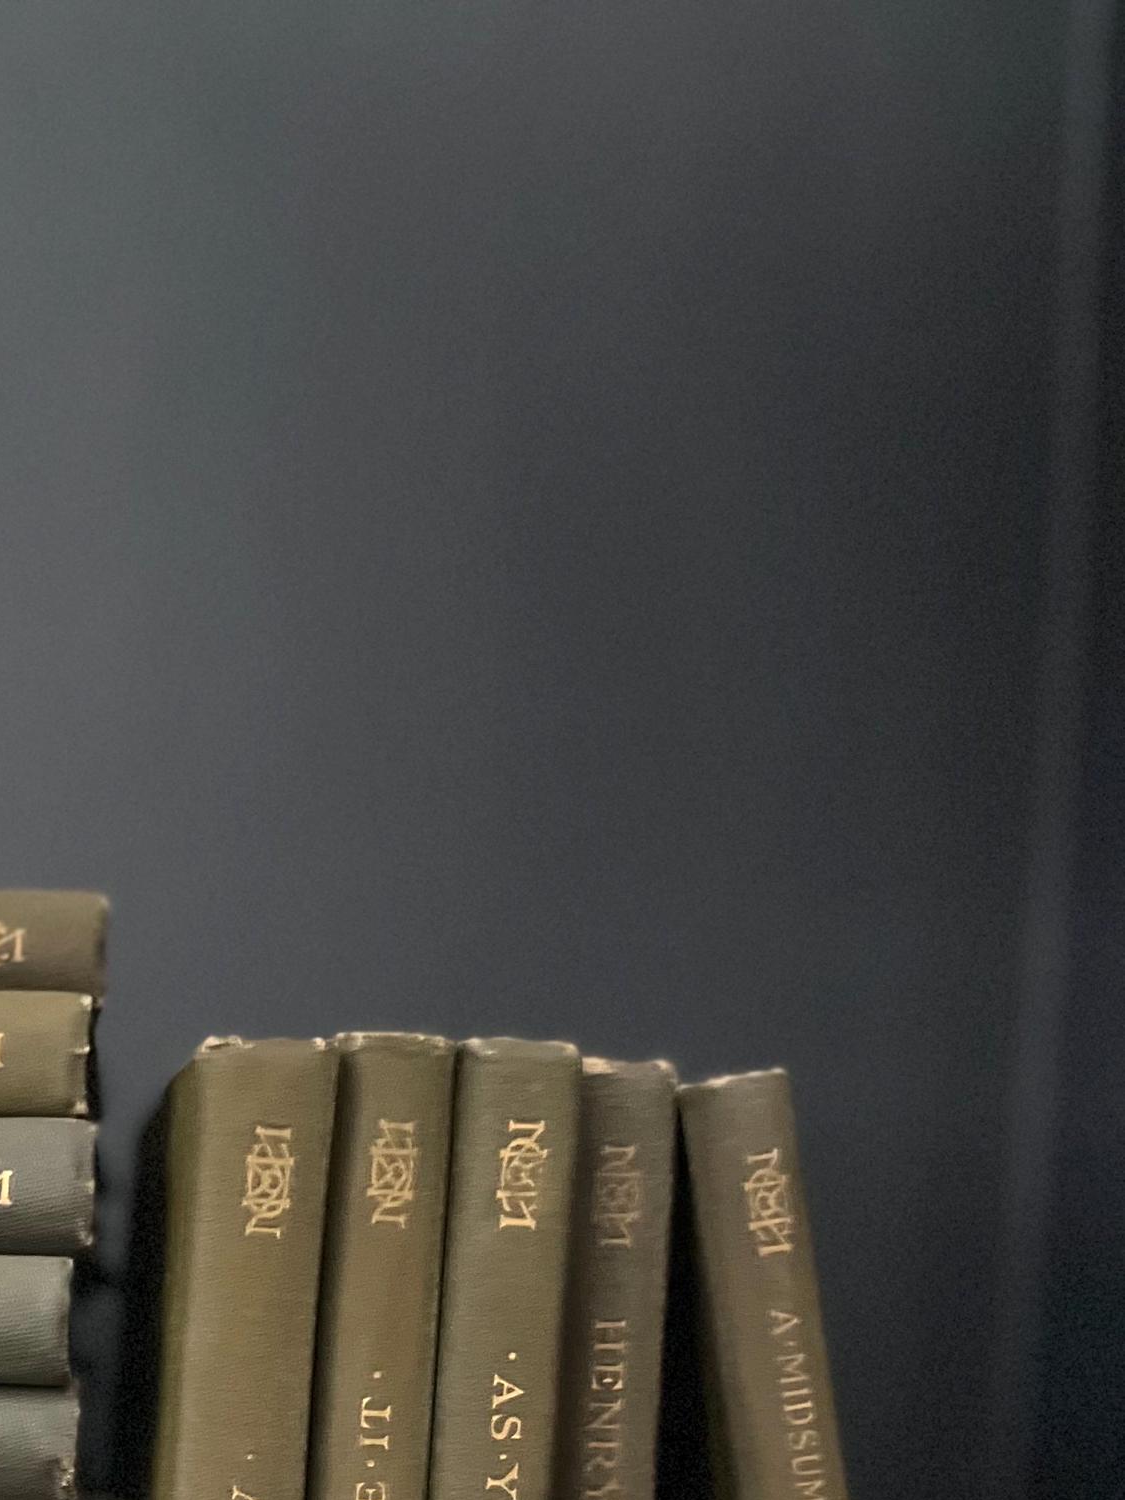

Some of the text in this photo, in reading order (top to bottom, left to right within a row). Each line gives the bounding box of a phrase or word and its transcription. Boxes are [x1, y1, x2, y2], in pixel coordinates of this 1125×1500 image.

[769, 1309, 801, 1335] A
[358, 1395, 393, 1451] IT
[490, 1374, 526, 1441] AS
